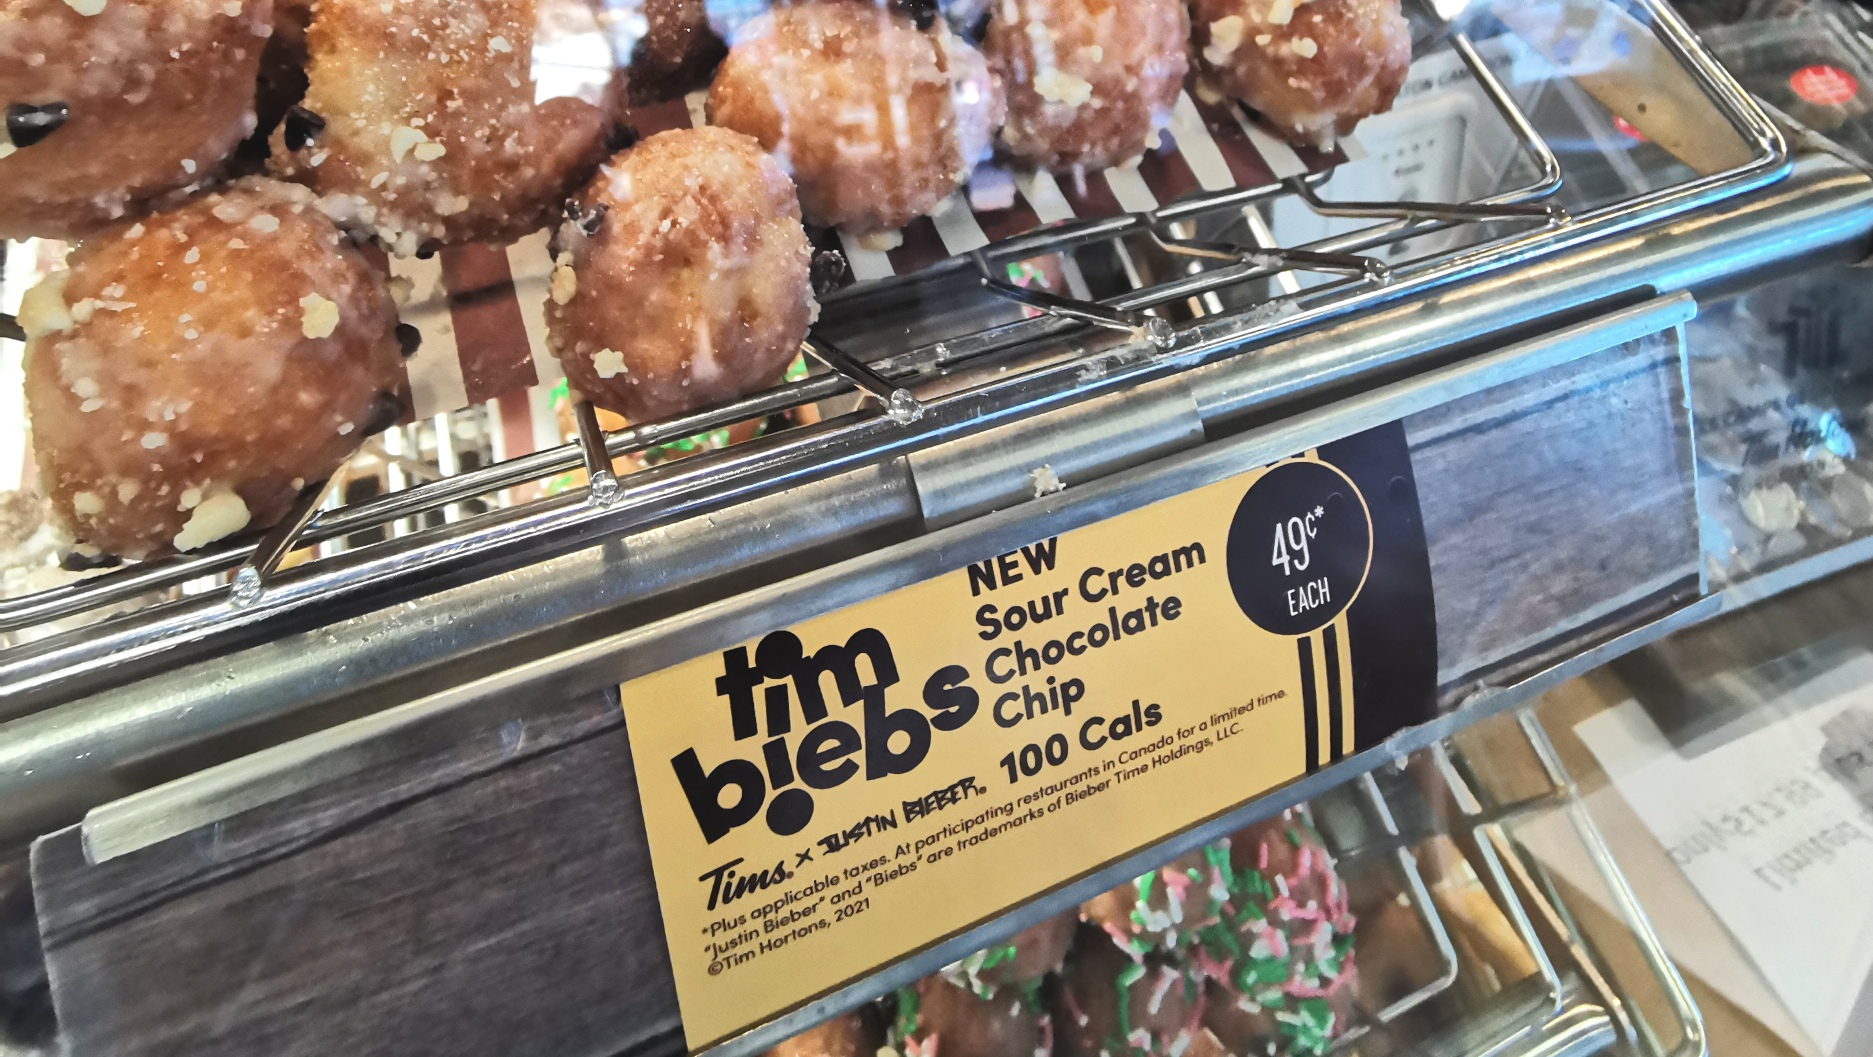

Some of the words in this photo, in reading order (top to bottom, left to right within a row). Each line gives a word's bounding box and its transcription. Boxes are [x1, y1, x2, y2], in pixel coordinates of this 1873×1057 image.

[967, 536, 1058, 597] NEW
[975, 587, 1069, 641] Sour
[1078, 541, 1207, 603] Cream
[1287, 577, 1331, 617] EACH
[985, 596, 1182, 684] Chocolate
[715, 628, 900, 741] tim
[993, 675, 1085, 728] Chip
[1000, 733, 1069, 784] 100
[1078, 699, 1163, 751] Cals
[750, 874, 841, 919] applicable
[843, 854, 891, 881] taxes.
[895, 842, 911, 860] At
[915, 802, 1014, 854] participating
[1017, 764, 1101, 808] restaurants
[1102, 759, 1116, 773] in
[1118, 735, 1174, 765] Canada
[1177, 724, 1196, 742] for
[1198, 721, 1208, 732] a
[1210, 699, 1254, 727] limited
[816, 809, 898, 856] JUSTIN
[830, 881, 863, 905] and
[927, 847, 953, 864] are
[957, 808, 1045, 852] trademarks
[1047, 797, 1062, 813] of
[1065, 779, 1111, 806] Bieber
[1114, 763, 1149, 784] Time
[1151, 737, 1214, 769] Holdings,
[1216, 722, 1244, 742] LLC.
[759, 918, 832, 955] Hortons,
[834, 897, 871, 923] 2021
